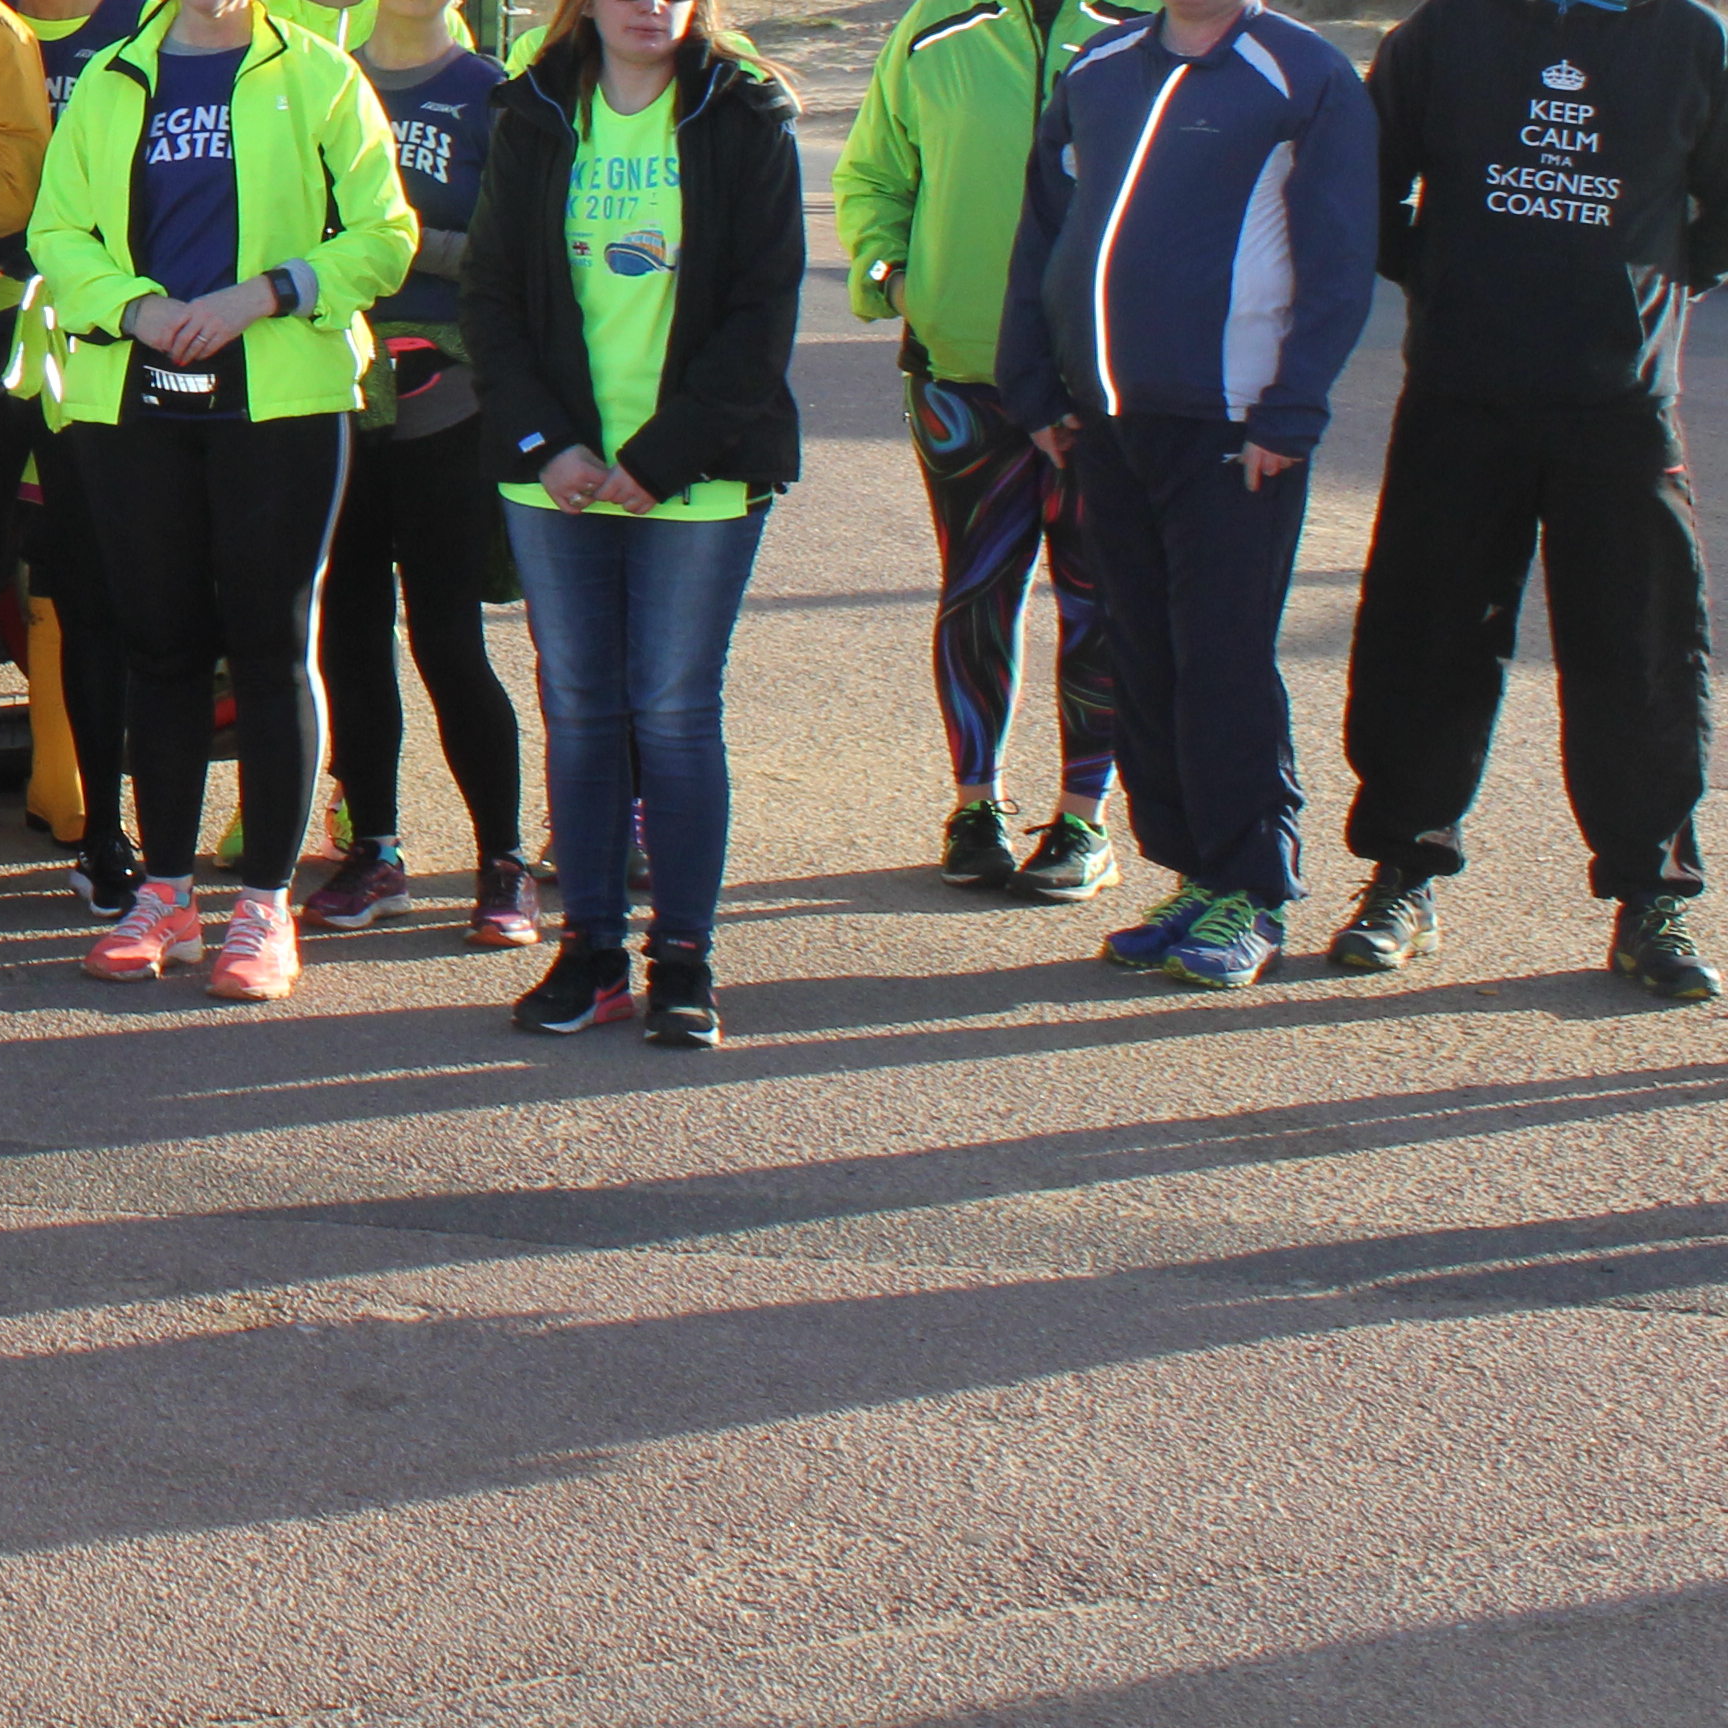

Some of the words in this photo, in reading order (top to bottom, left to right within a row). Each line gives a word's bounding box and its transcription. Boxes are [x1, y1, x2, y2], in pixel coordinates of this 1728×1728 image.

[1530, 99, 1595, 125] KEEP
[1520, 125, 1600, 153] CALM
[1561, 156, 1574, 168] A
[1486, 164, 1622, 200] SKEGNESS
[585, 195, 640, 220] 2017
[1486, 191, 1612, 226] COASTER
